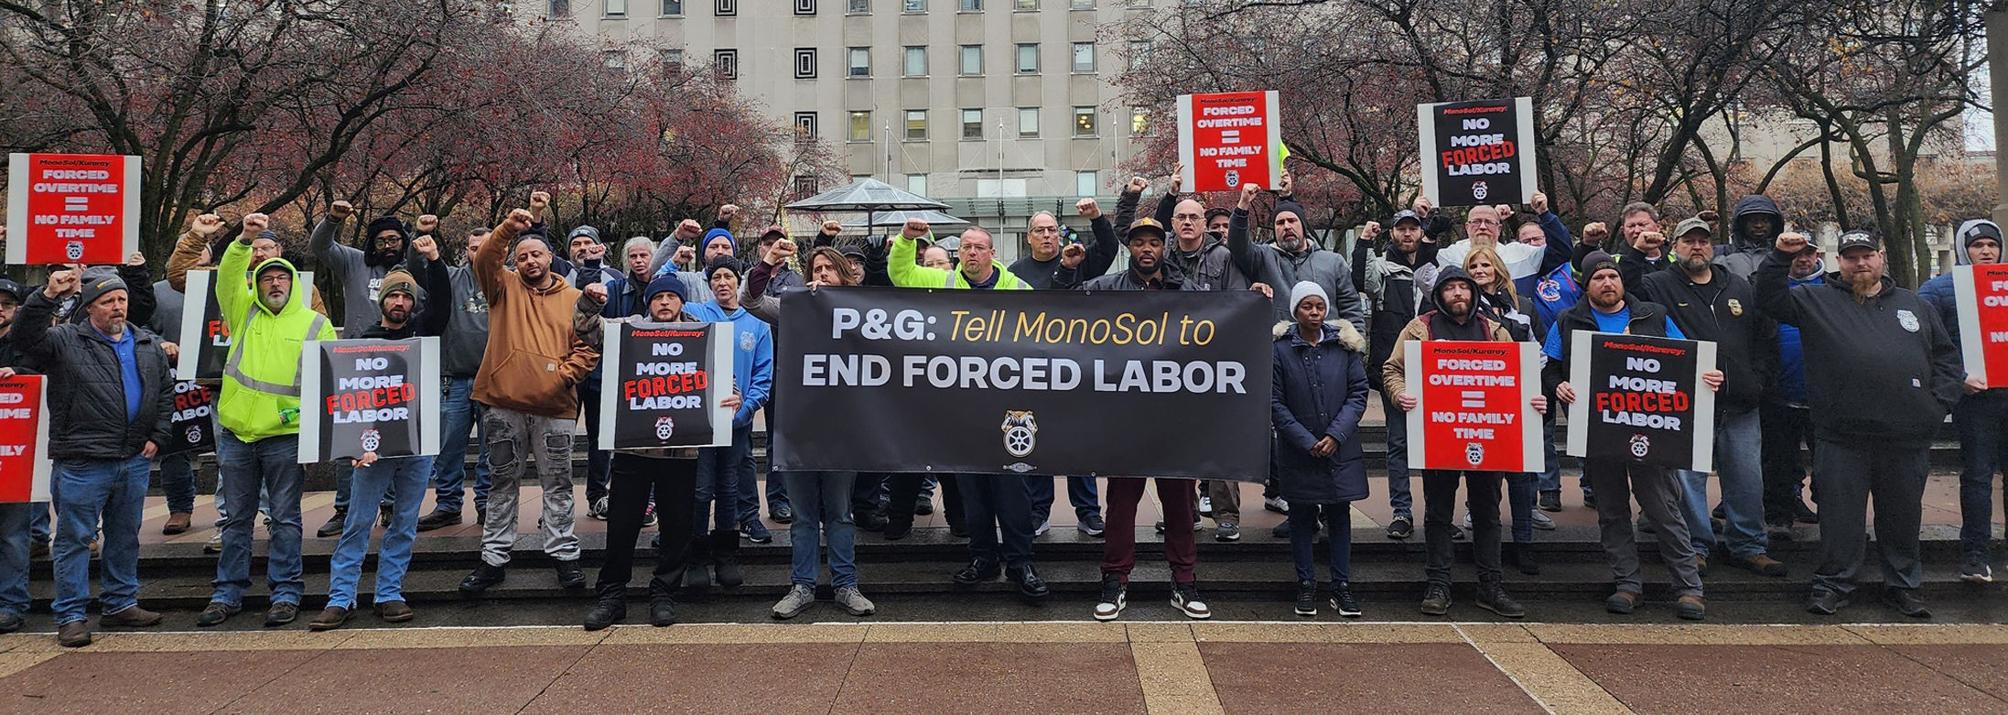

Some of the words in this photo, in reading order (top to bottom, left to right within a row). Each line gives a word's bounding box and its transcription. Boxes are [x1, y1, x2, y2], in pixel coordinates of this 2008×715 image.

[1203, 105, 1255, 116] FORCED
[1197, 117, 1262, 128] OVERTIME
[1462, 118, 1490, 130] NO
[1450, 133, 1504, 147] MORE
[1200, 147, 1218, 157] NO
[1219, 145, 1262, 156] FAMILY
[1441, 140, 1516, 169] FORCED
[1216, 158, 1247, 168] TIME
[1448, 162, 1511, 176] LABOR
[42, 169, 109, 180] FORCED
[34, 183, 118, 193] OVERTIME
[35, 215, 59, 225] NO
[60, 215, 115, 225] FAMILY
[55, 228, 95, 238] TIME
[832, 307, 937, 341] P&G:
[950, 309, 1006, 343] Tell
[1013, 310, 1169, 345] MonoSol
[1179, 314, 1215, 346] to
[652, 342, 683, 356] NO
[355, 357, 388, 371] NO
[636, 361, 697, 376] MORE
[1437, 359, 1506, 371] FORCED
[1626, 356, 1661, 373] NO
[802, 354, 892, 387] END
[903, 355, 1082, 390] FORCED
[1094, 359, 1247, 394] LABOR
[1429, 374, 1515, 387] OVERTIME
[339, 374, 404, 391] MORE
[624, 369, 709, 401] FORCED
[1609, 375, 1677, 395] MORE
[326, 382, 416, 415] FORCED
[630, 395, 701, 410] LABOR
[1595, 391, 1690, 413] FORCED
[333, 407, 408, 424] LABOR
[1432, 411, 1456, 423] NO
[1458, 412, 1515, 424] FAMILY
[1602, 409, 1681, 431] LABOR
[1453, 427, 1495, 440] TIME
